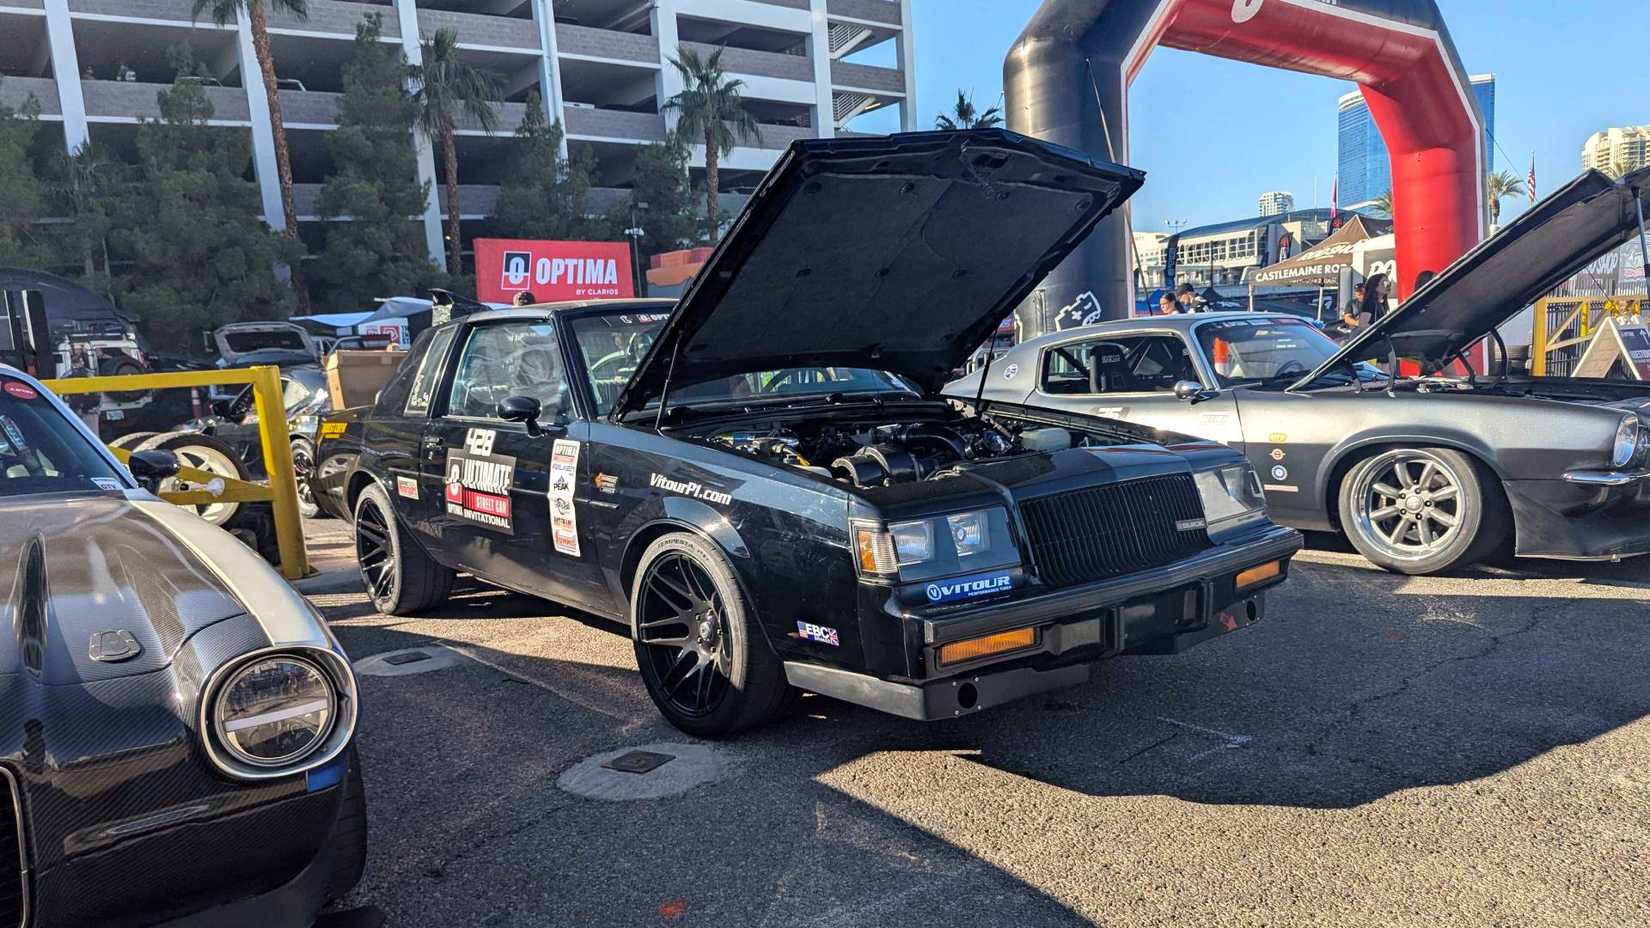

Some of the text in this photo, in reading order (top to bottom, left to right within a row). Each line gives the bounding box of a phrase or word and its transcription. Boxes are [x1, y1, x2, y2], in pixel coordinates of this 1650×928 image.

[536, 257, 618, 285] OPTIMA
[1255, 264, 1323, 282] CASTLEMAINE
[576, 288, 585, 296] BY
[465, 427, 497, 457] 428
[462, 458, 513, 496] ULTIMATE
[553, 482, 570, 492] PEAK
[649, 472, 732, 505] VitourP1.com
[495, 498, 507, 515] CAR
[463, 508, 511, 529] INVITATIONAL
[940, 575, 1011, 596] VITOUR
[804, 623, 829, 639] EBC
